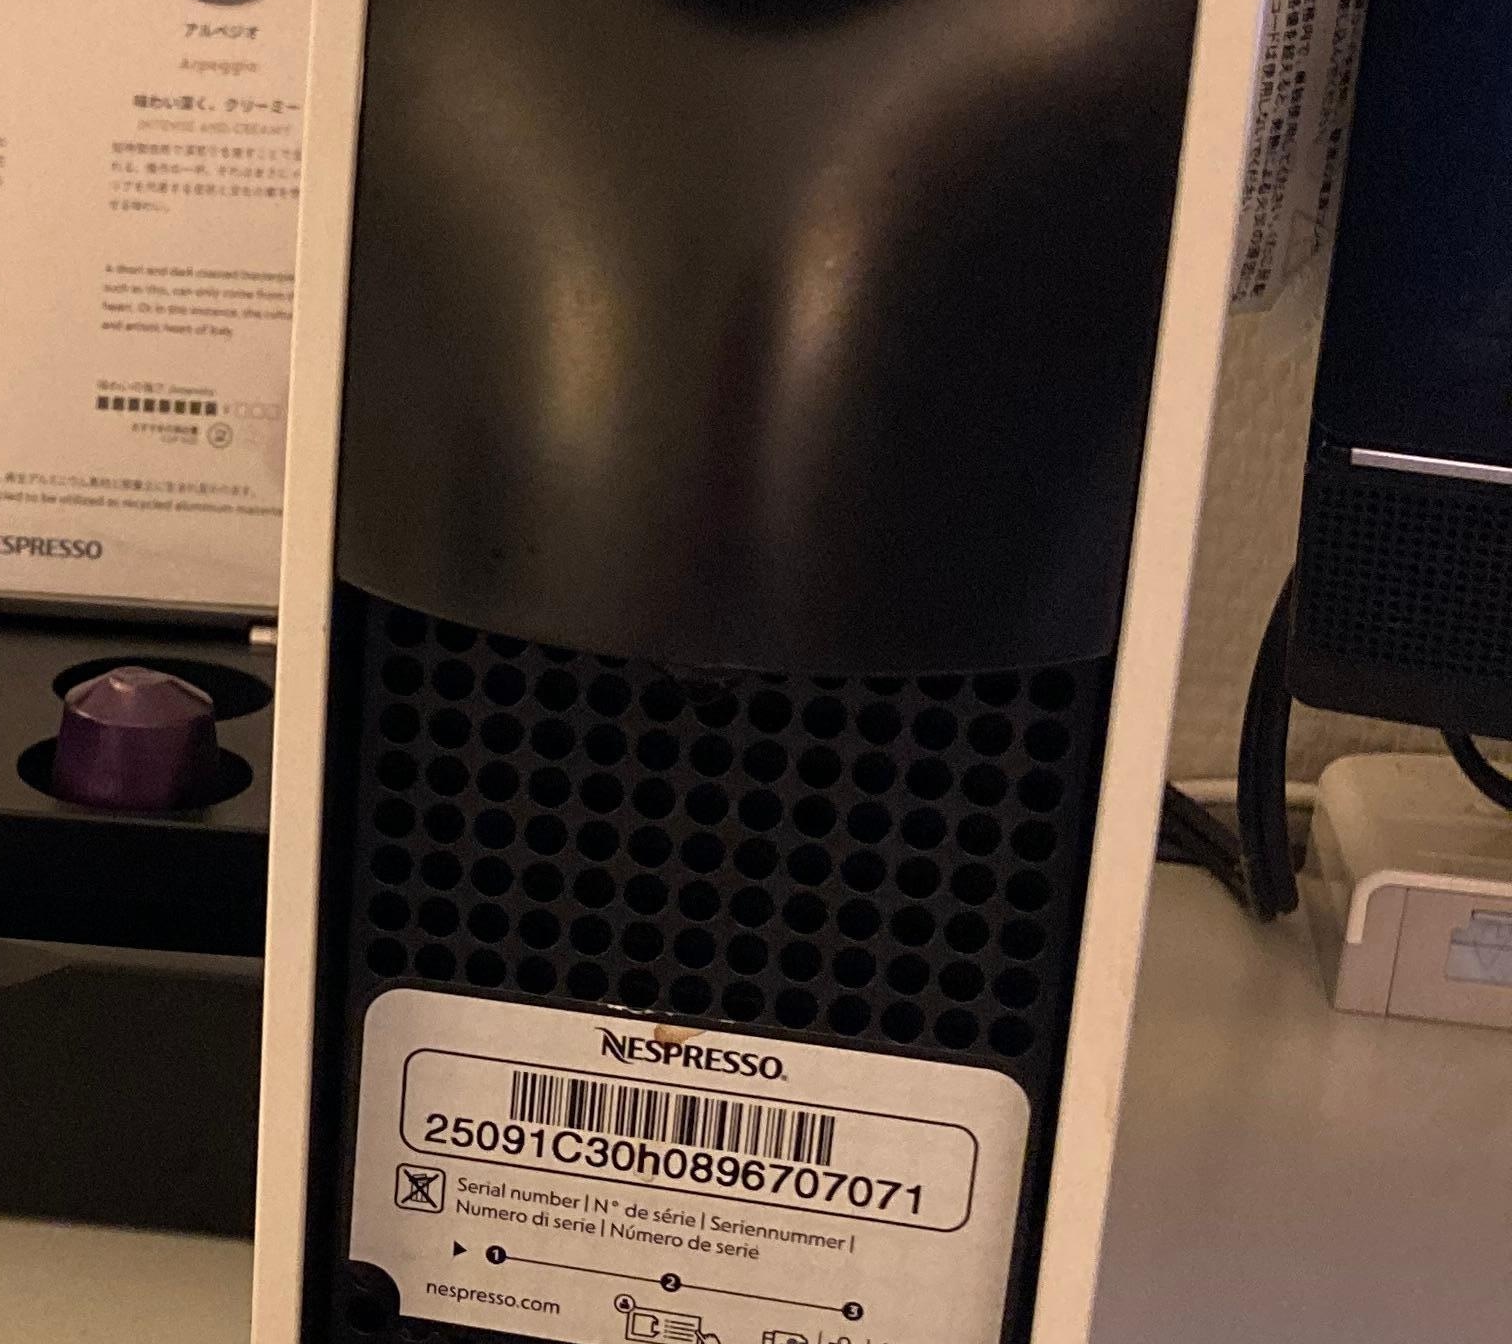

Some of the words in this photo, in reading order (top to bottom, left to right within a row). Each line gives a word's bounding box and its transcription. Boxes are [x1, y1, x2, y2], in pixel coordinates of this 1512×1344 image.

[595, 1027, 785, 1081] NESPRESSO
[424, 1112, 924, 1216] 25091C30h0896707071
[456, 1199, 528, 1225] Numero
[532, 1211, 549, 1228] di
[553, 1217, 597, 1235] serie
[610, 1222, 684, 1249] Número
[688, 1235, 713, 1253] de
[715, 1243, 761, 1260] serie
[457, 1177, 506, 1199] Serial
[510, 1187, 581, 1210] number
[594, 1198, 620, 1215] N°
[625, 1204, 649, 1220] de
[653, 1206, 697, 1229] série
[710, 1215, 846, 1251] Seriennummer
[426, 1281, 561, 1315] nespresso.com
